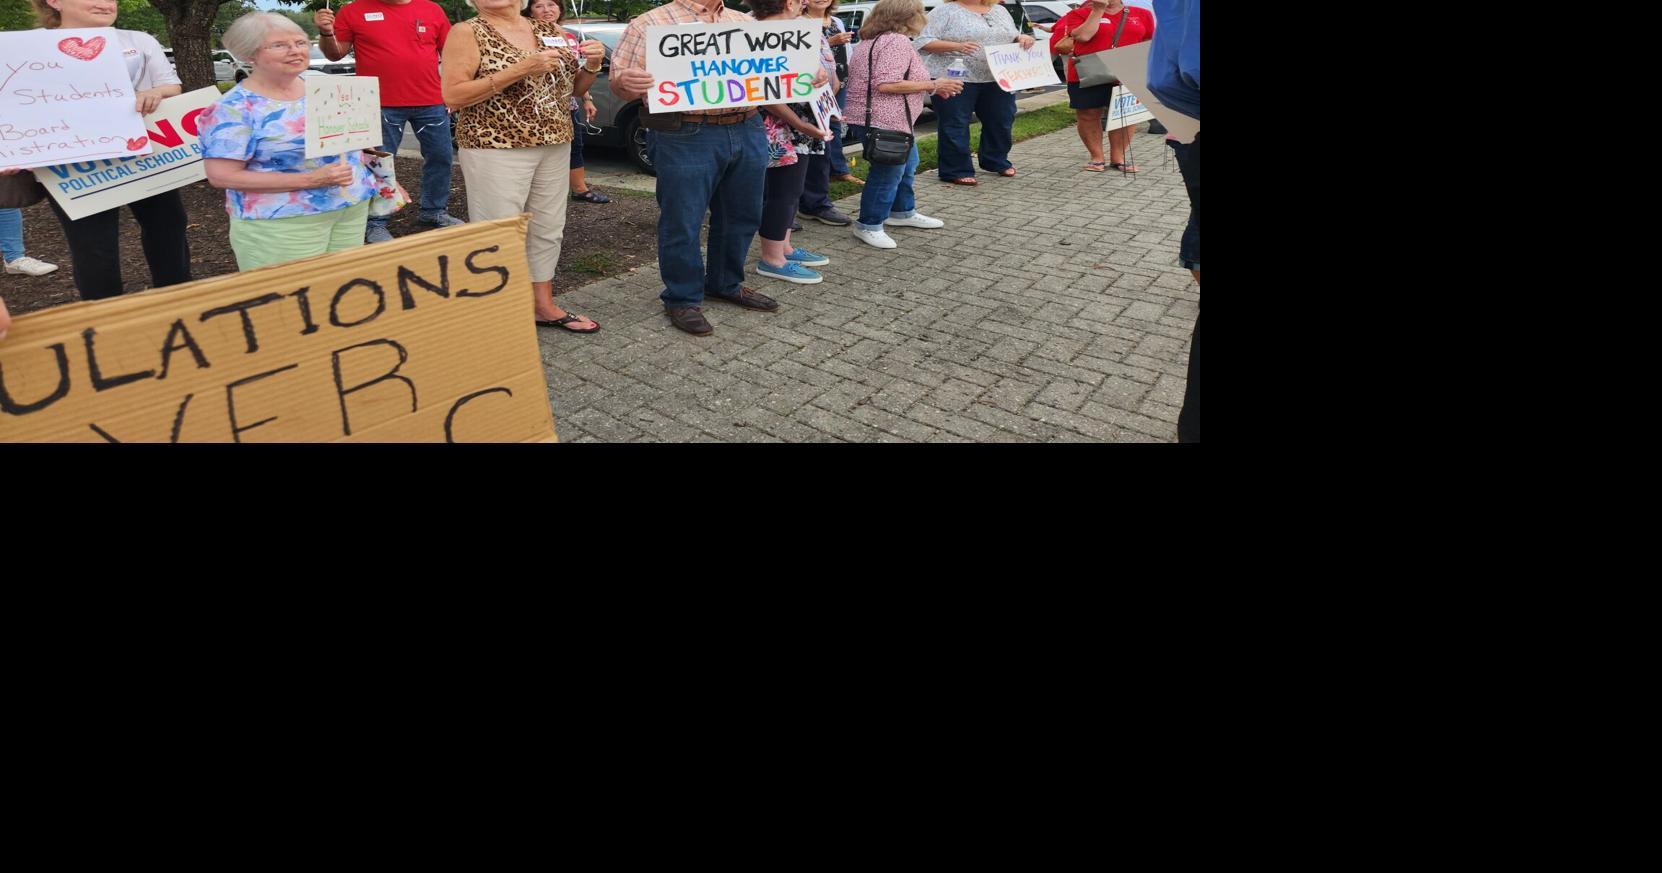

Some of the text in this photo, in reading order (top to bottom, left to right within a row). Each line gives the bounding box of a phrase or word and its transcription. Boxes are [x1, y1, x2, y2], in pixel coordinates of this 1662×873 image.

[659, 28, 813, 57] GREAT WORK
[690, 56, 788, 77] HANOVER
[13, 82, 125, 106] Students
[658, 73, 814, 107] STUDENTS
[0, 119, 71, 142] Board
[58, 164, 137, 194] POLITICAL
[138, 147, 194, 172] SCHOOL
[0, 244, 510, 416] ULATIONS
